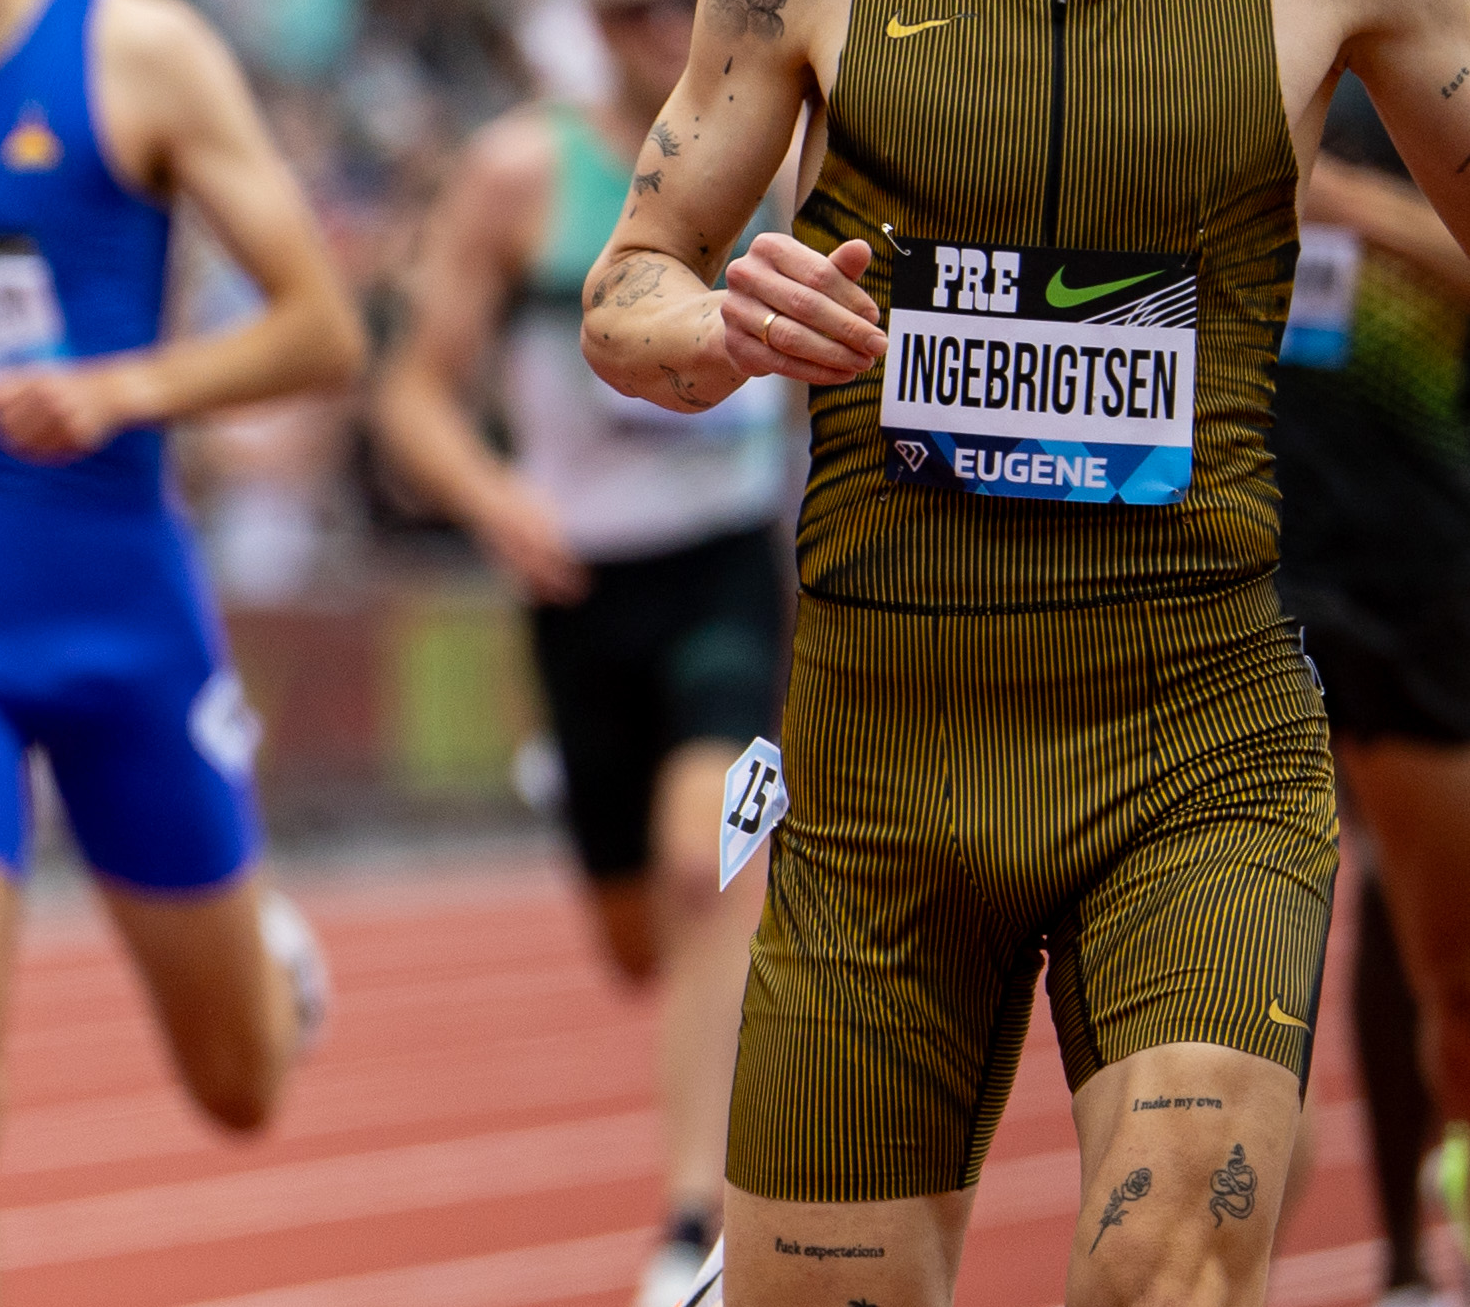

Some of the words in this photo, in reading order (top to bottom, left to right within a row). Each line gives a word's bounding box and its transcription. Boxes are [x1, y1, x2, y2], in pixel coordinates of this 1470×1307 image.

[932, 246, 1020, 313] PRE
[897, 332, 1178, 420] INGEBRIGTSEN
[954, 447, 1108, 489] EUGENE
[727, 760, 777, 834] 15
[1140, 1095, 1171, 1110] make
[1174, 1097, 1194, 1110] my
[1196, 1096, 1223, 1109] own
[803, 1243, 885, 1261] expectations
